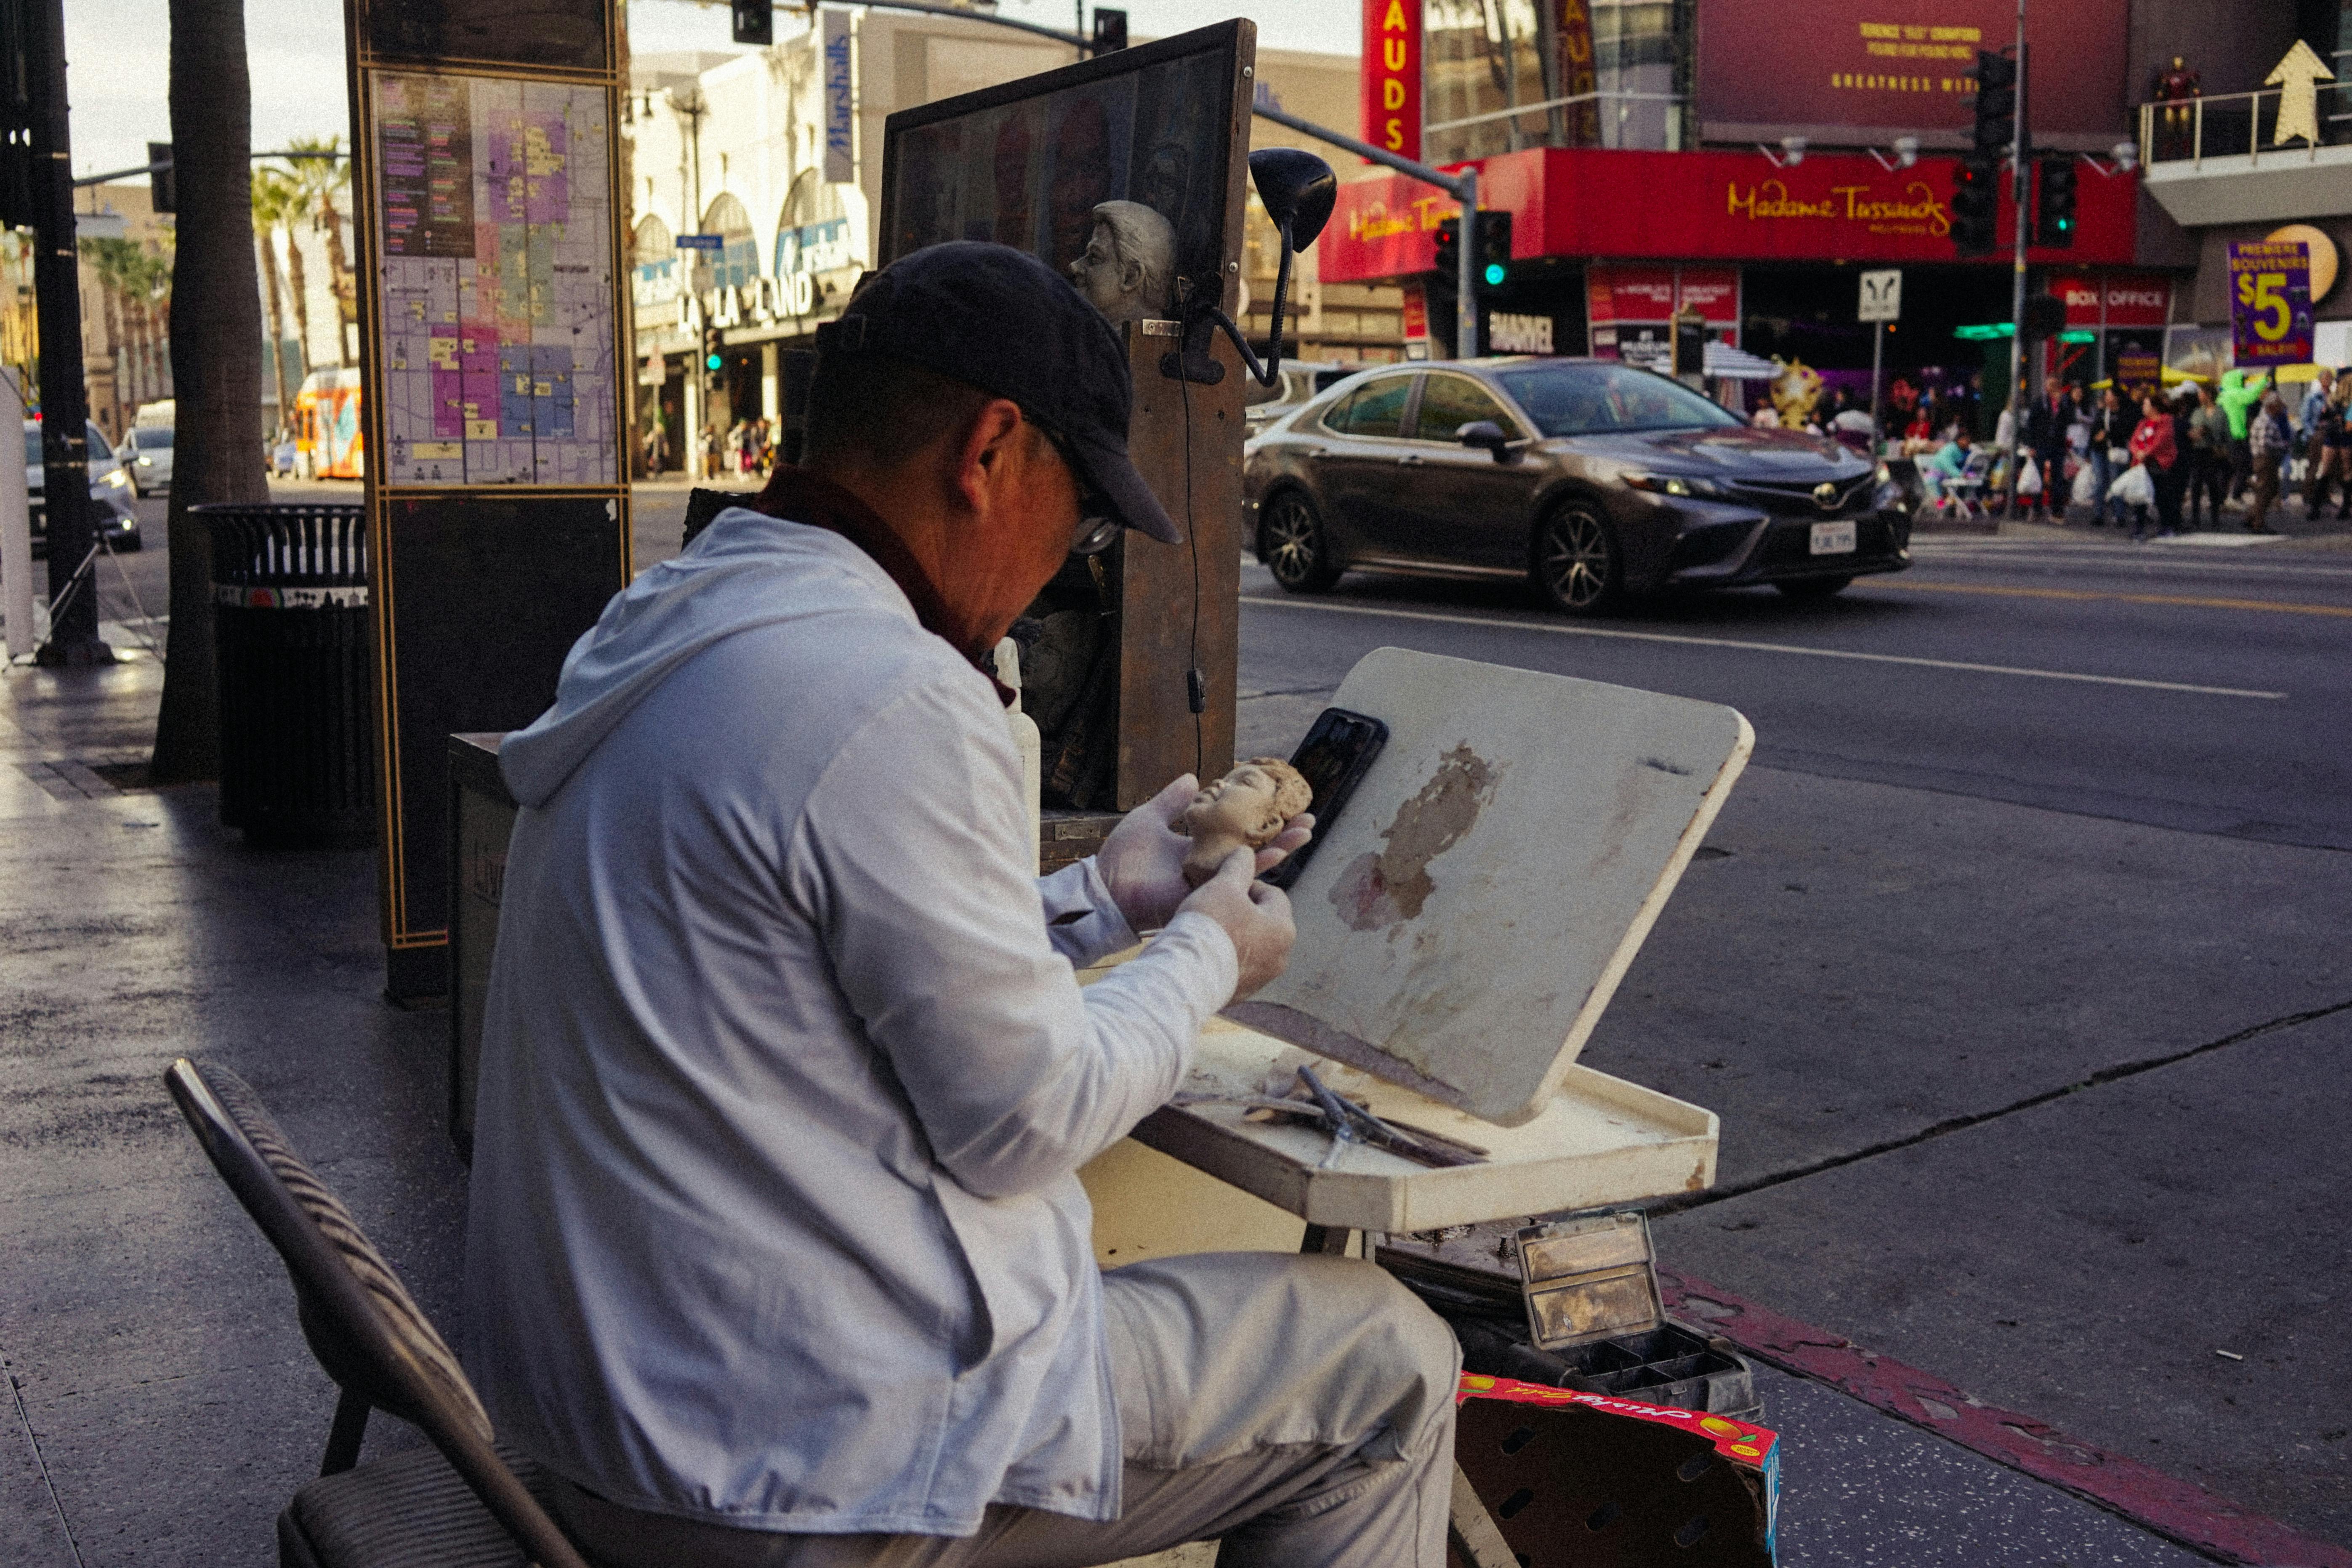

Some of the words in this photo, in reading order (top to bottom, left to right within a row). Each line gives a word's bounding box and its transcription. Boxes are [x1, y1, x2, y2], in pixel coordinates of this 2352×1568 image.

[1727, 178, 1836, 221] Madame
[1831, 181, 1951, 237] Tussauds
[712, 284, 741, 328] LA
[755, 271, 813, 322] LAND
[2066, 290, 2098, 306] BOX
[2107, 290, 2163, 306] OFFICE
[2238, 272, 2291, 341] $5
